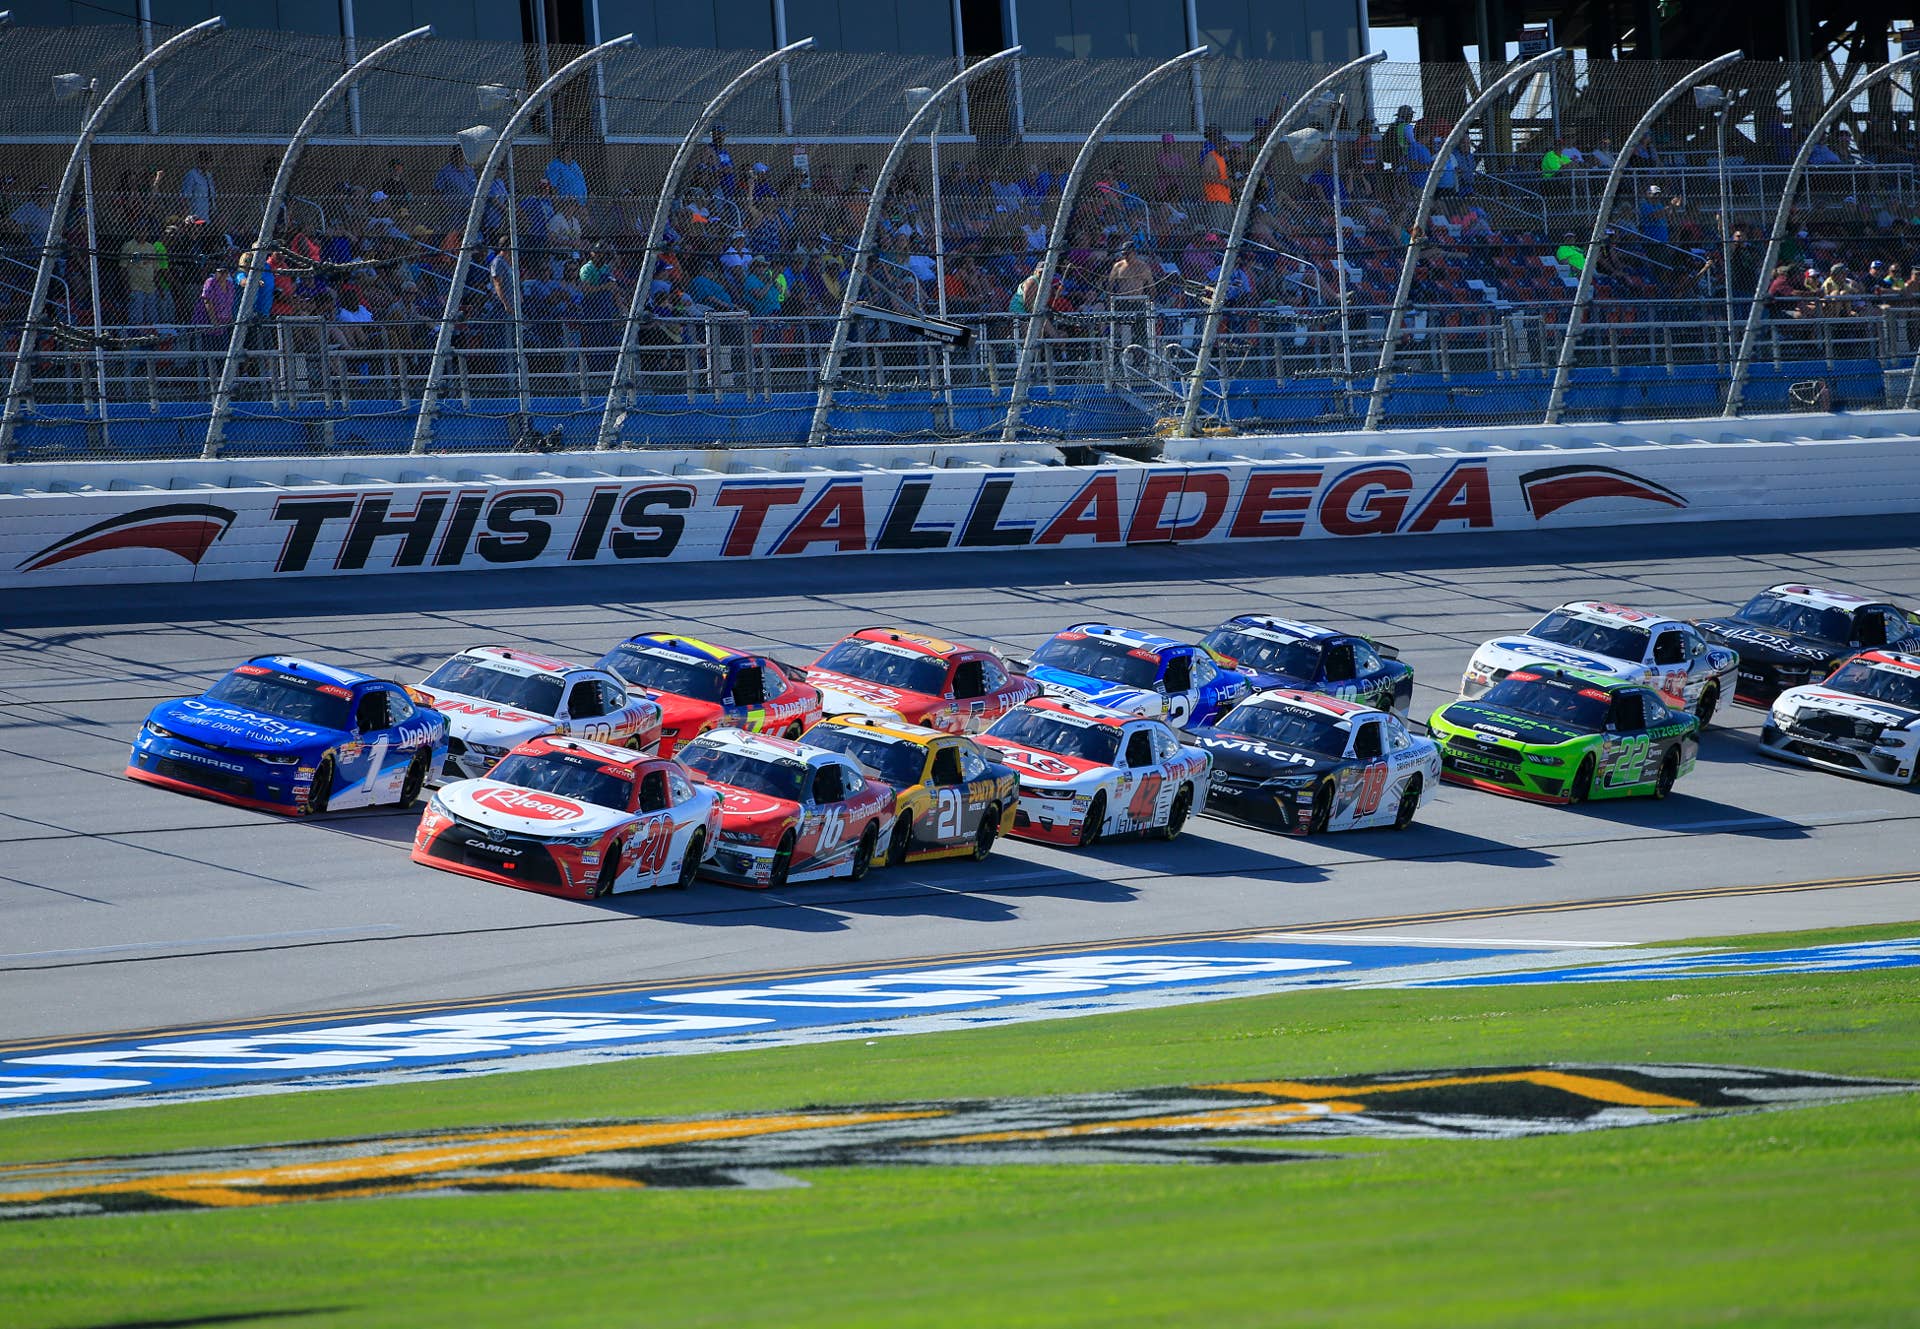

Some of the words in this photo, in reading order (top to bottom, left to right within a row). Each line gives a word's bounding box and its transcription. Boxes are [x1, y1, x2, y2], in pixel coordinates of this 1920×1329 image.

[271, 489, 565, 573] THIS
[567, 483, 698, 562] IS
[713, 457, 1495, 559] TALLADEGA
[1694, 622, 1830, 661] CHILDRESS
[279, 674, 308, 685] SADLER
[182, 699, 318, 737] OneMain
[1170, 694, 1190, 729] 2
[1282, 705, 1316, 719] xfinity
[1452, 704, 1579, 737] FITZGERALD
[246, 729, 292, 745] HUMAN
[739, 748, 760, 757] REED
[361, 733, 389, 793] 1
[563, 755, 583, 765] BELL
[1609, 733, 1650, 786] 22
[483, 787, 578, 821] Rheem
[1210, 783, 1243, 796] MRY
[1353, 760, 1388, 820] 18
[815, 805, 845, 856] 16
[937, 787, 962, 840] 21
[465, 839, 523, 857] CAMRY
[637, 812, 674, 878] 20
